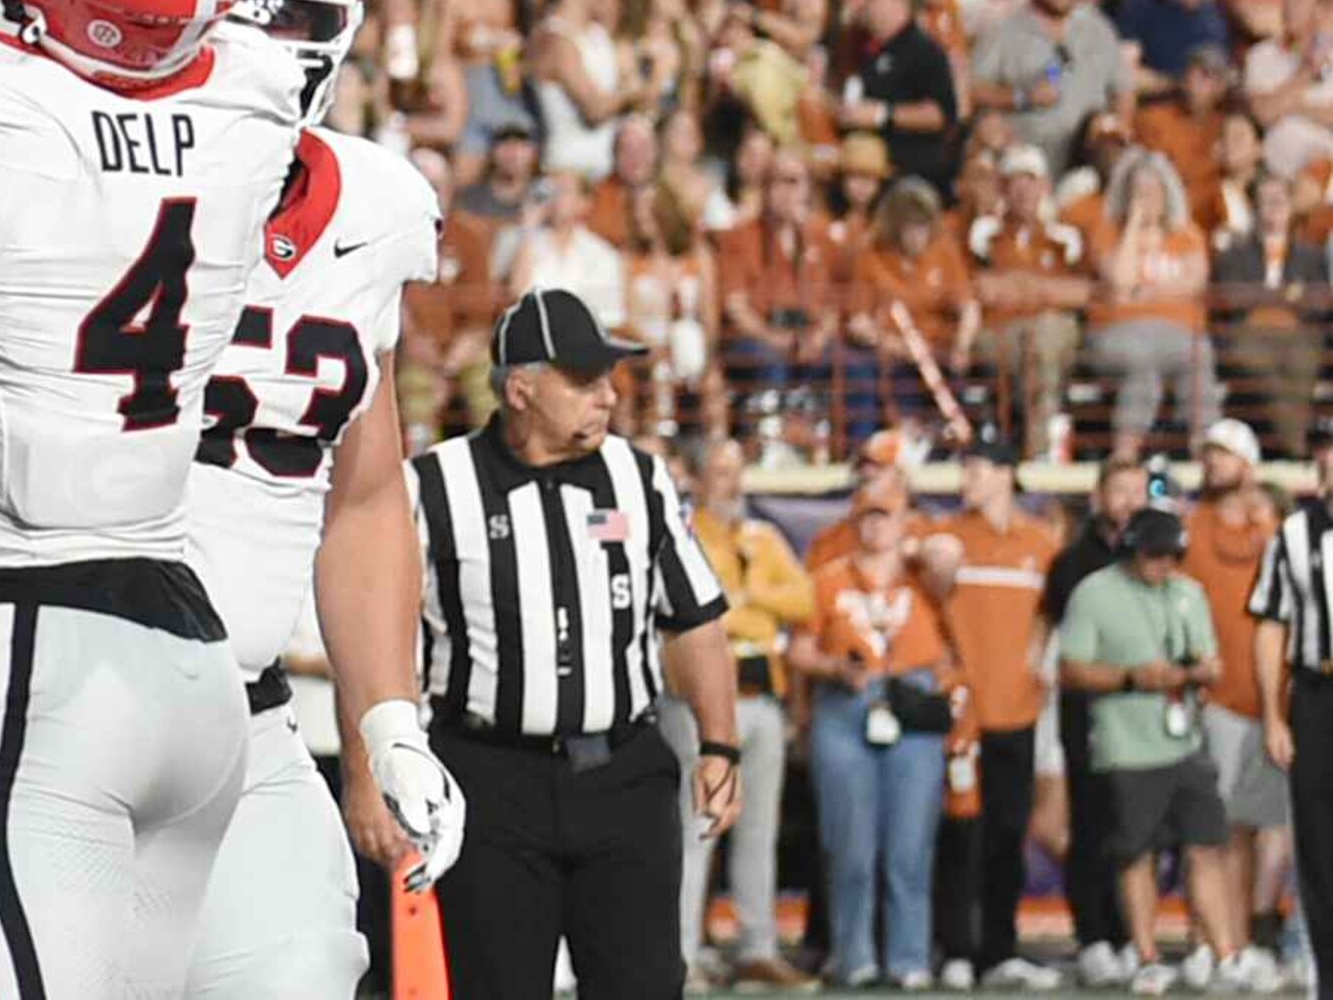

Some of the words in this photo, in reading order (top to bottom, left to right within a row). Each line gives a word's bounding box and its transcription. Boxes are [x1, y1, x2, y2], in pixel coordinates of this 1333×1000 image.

[91, 110, 195, 178] DELP
[73, 197, 197, 432] 4
[488, 514, 511, 539] S
[612, 573, 632, 610] S
